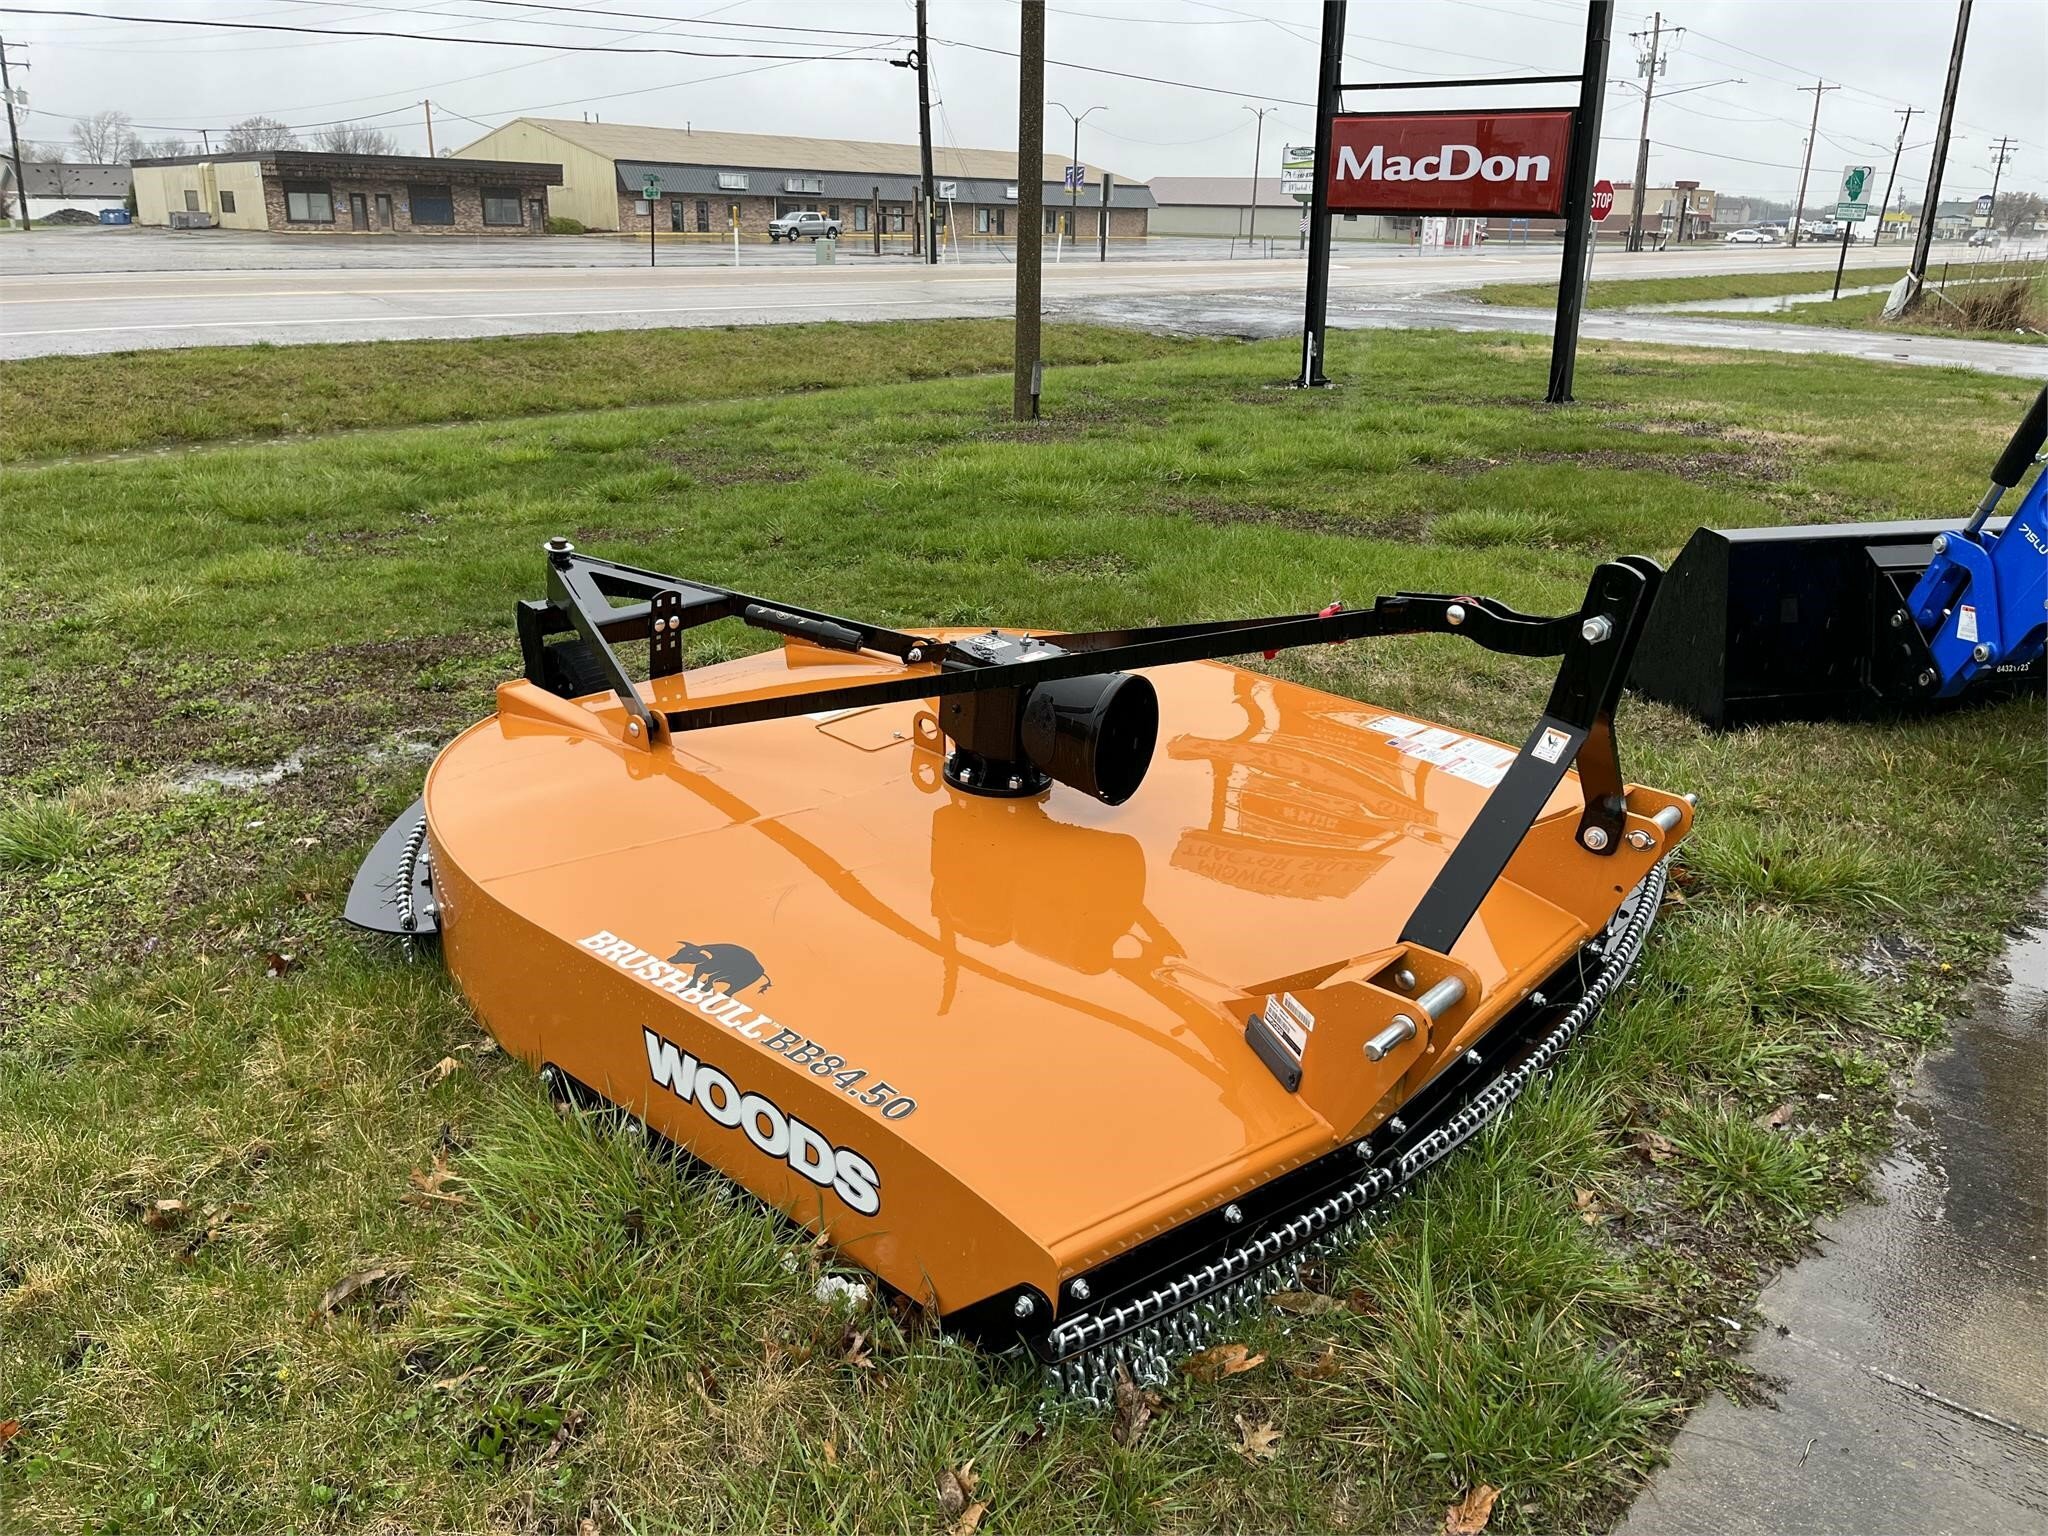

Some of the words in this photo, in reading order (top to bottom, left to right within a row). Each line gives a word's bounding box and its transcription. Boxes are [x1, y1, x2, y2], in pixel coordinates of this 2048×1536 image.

[1335, 145, 1550, 182] MacDon
[1591, 193, 1613, 209] STOP
[759, 1027, 918, 1122] BB84.50
[642, 1024, 882, 1217] WOODS
